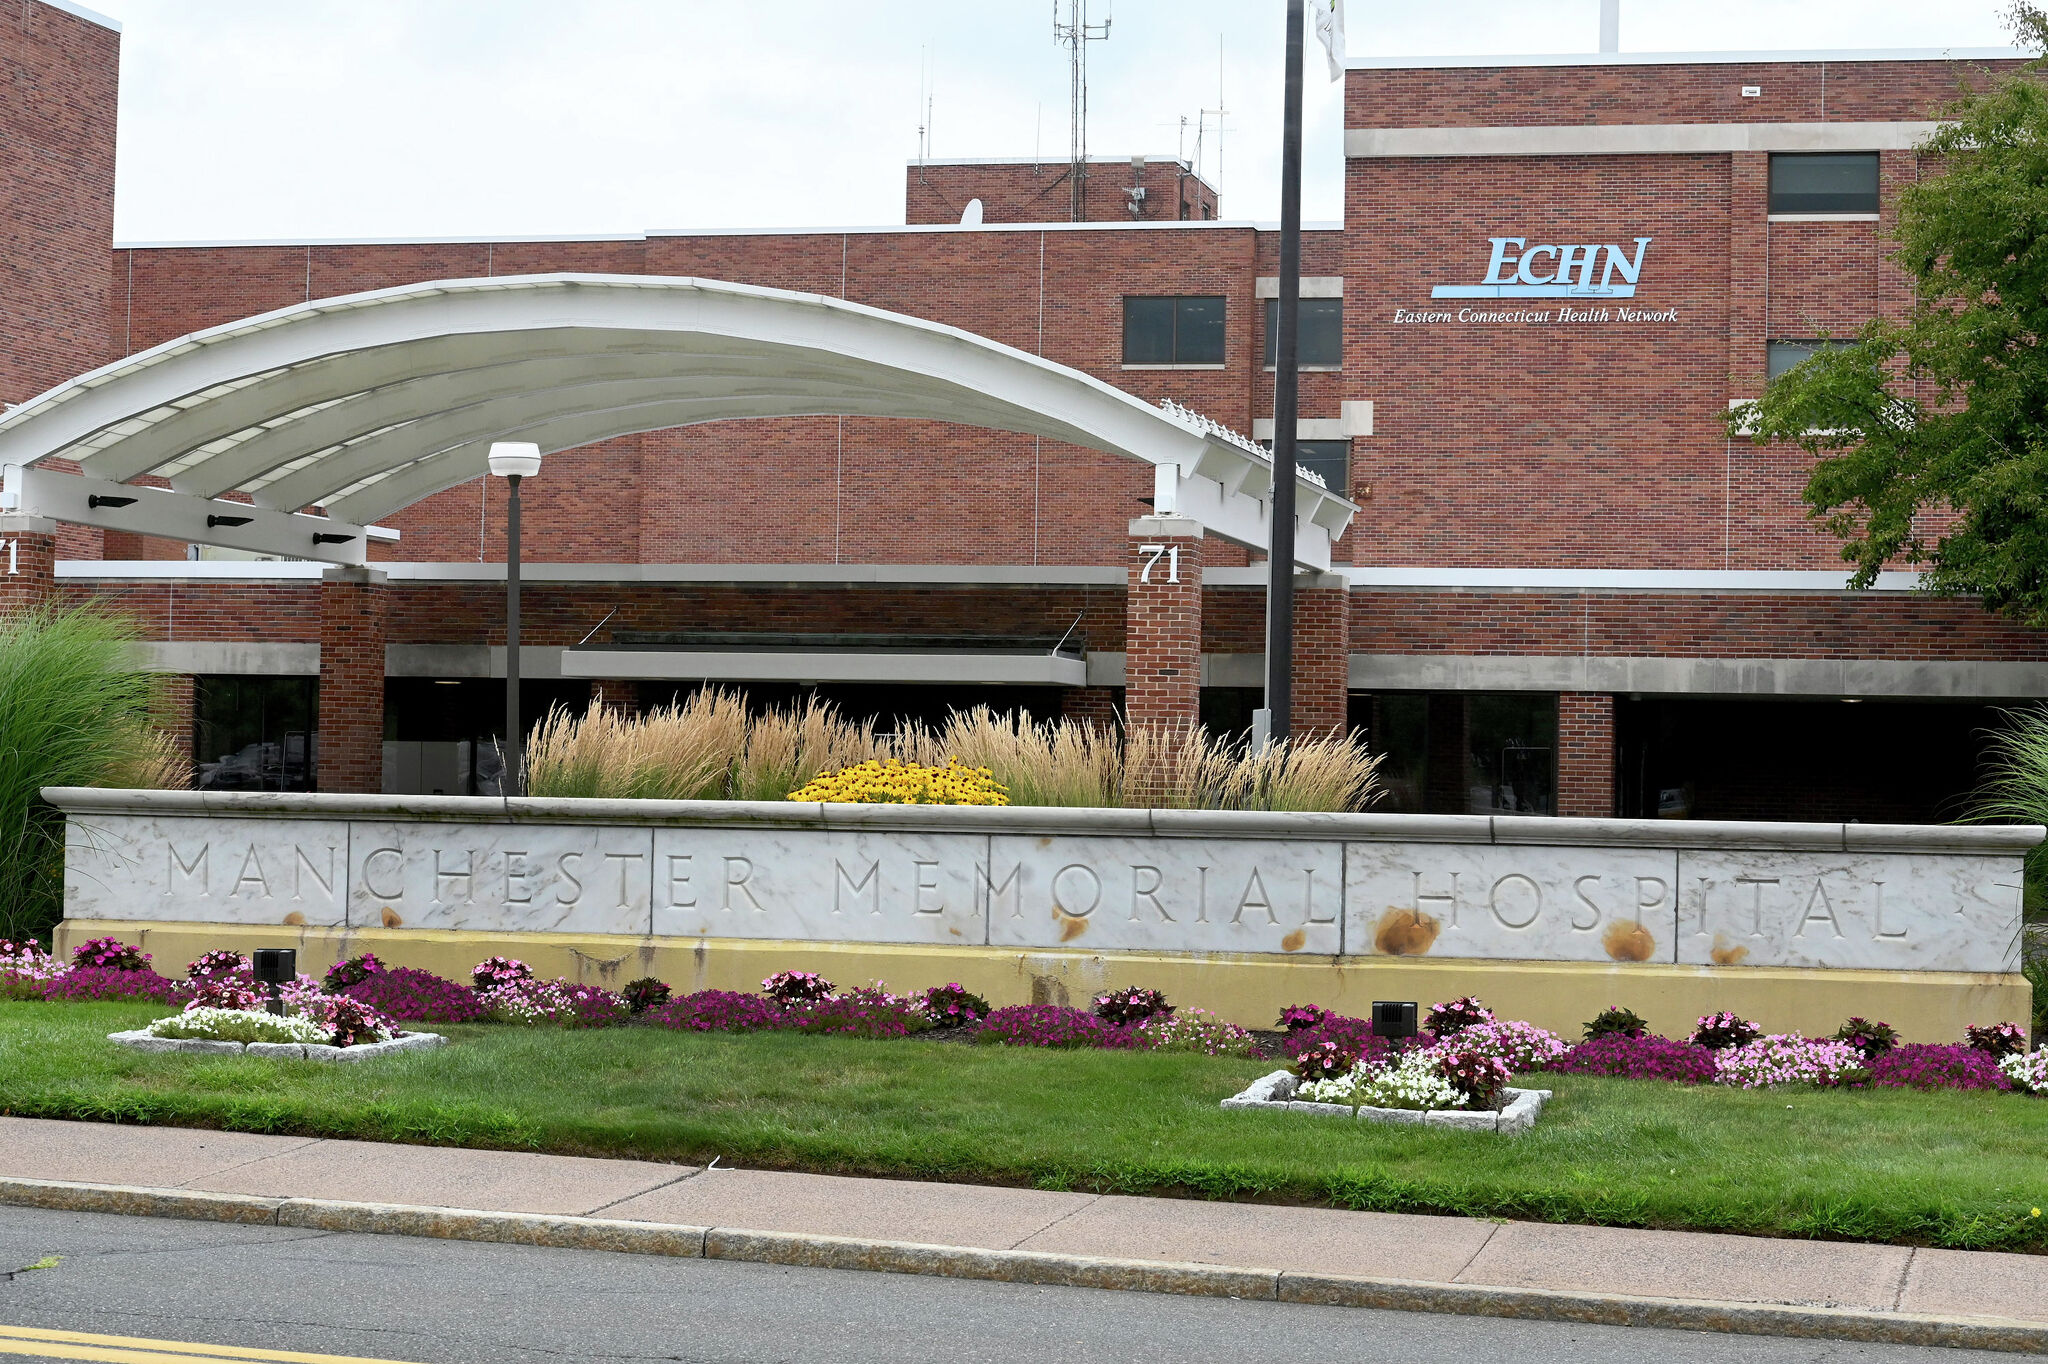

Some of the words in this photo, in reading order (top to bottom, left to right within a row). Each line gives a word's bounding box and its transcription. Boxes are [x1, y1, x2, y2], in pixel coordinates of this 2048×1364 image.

[1393, 309, 1451, 324] Eastern
[1458, 308, 1550, 323] Connecticut
[1557, 308, 1609, 323] Health
[1616, 307, 1678, 322] Network
[0, 539, 19, 575] 1
[1138, 544, 1180, 584] 71
[165, 840, 767, 913] MANCHESTER
[832, 857, 1335, 927] MEMORIAL
[1412, 871, 1908, 942] HOSPITAL
